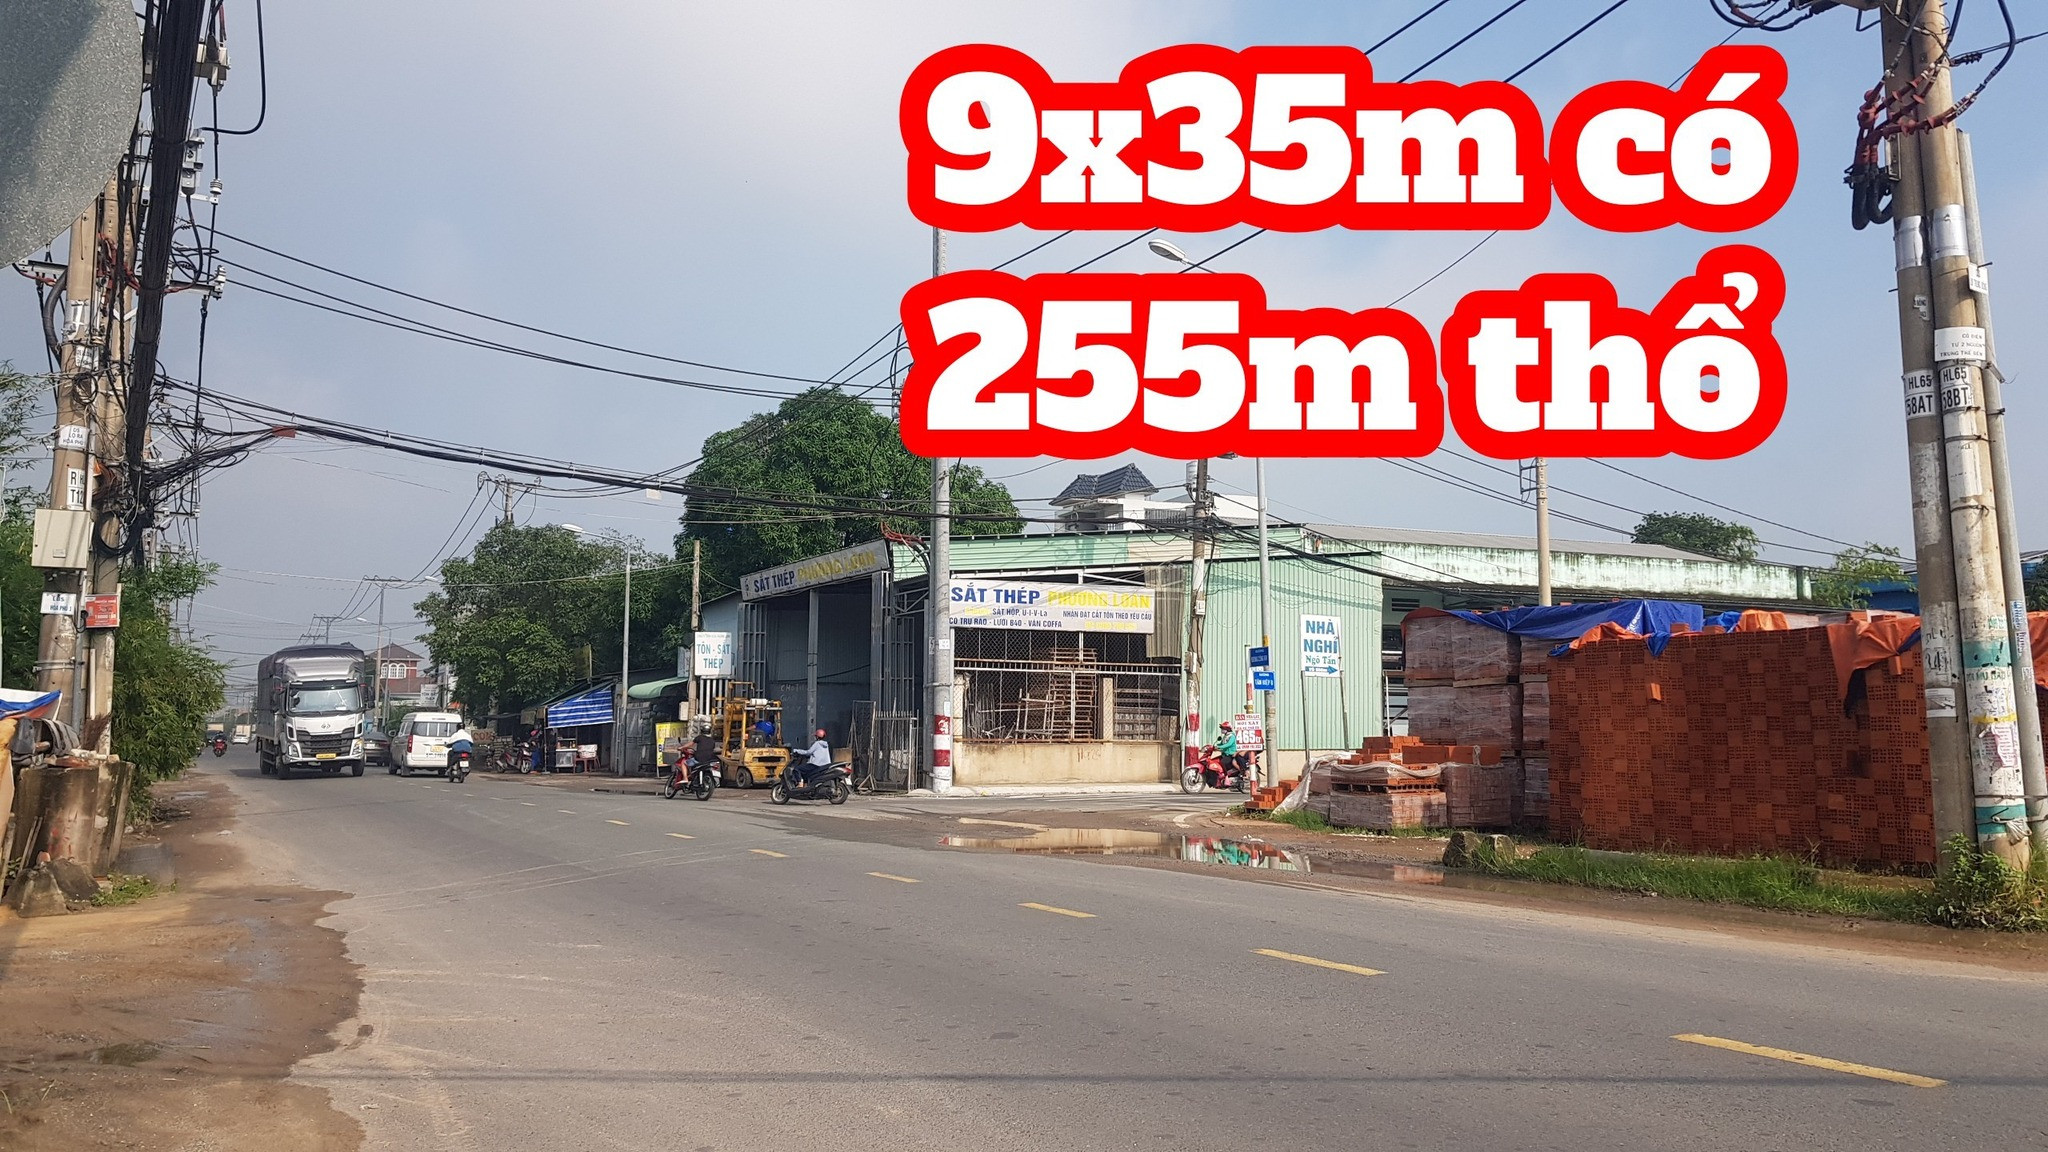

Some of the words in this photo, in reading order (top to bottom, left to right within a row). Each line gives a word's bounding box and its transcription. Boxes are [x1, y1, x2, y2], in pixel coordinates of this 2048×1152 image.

[1908, 374, 1932, 390] HL65
[1943, 366, 1967, 383] HL65
[1906, 394, 1933, 416] 58AT
[753, 572, 771, 593] SẮT
[772, 568, 796, 588] THÉP
[951, 582, 988, 603] SẮT
[993, 586, 1041, 605] THÉP
[1113, 592, 1151, 609] LOAN
[1043, 620, 1062, 628] COFFA
[1116, 612, 1129, 620] THEO
[1305, 618, 1335, 635] NHÀ
[697, 641, 711, 655] TÔN
[1303, 635, 1338, 654] NGHỈ
[703, 655, 724, 669] THÉP
